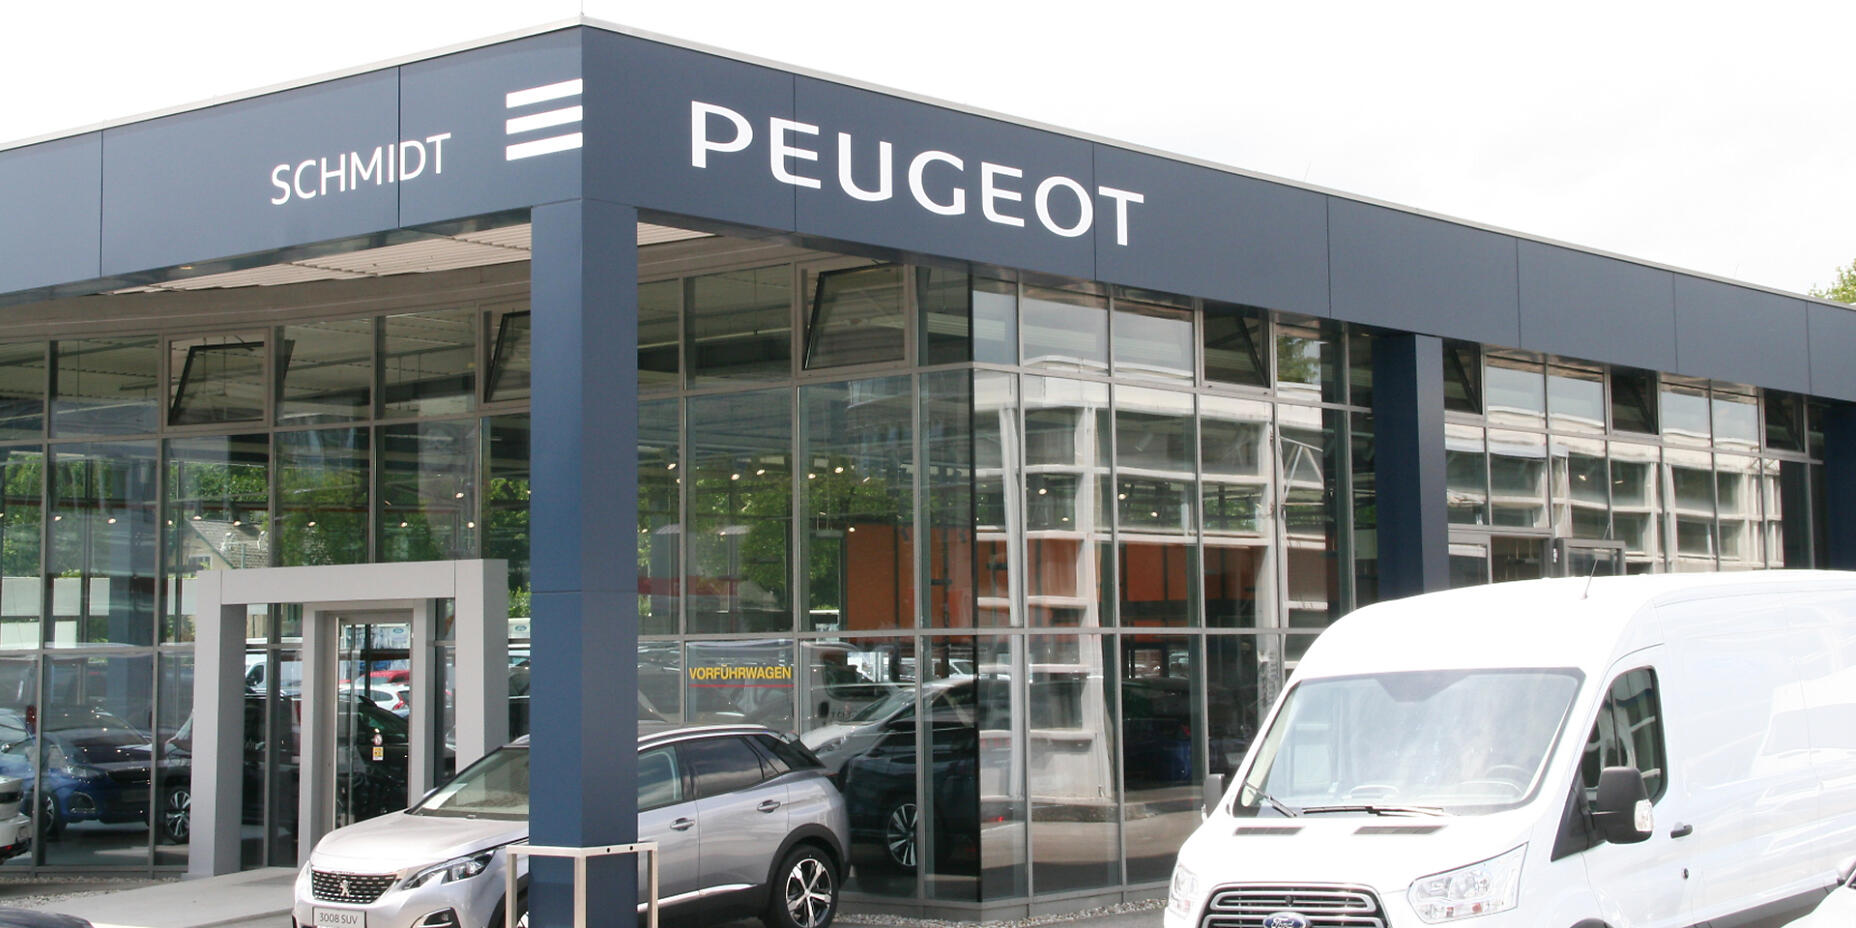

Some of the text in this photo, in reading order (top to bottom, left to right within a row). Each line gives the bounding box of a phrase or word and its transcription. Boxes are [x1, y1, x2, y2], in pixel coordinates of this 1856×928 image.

[271, 132, 452, 206] SCHMIDT
[692, 101, 1145, 247] PEUGEOT
[689, 664, 793, 680] VORFÜHRWAGEN
[319, 912, 358, 924] 3008 SUV
